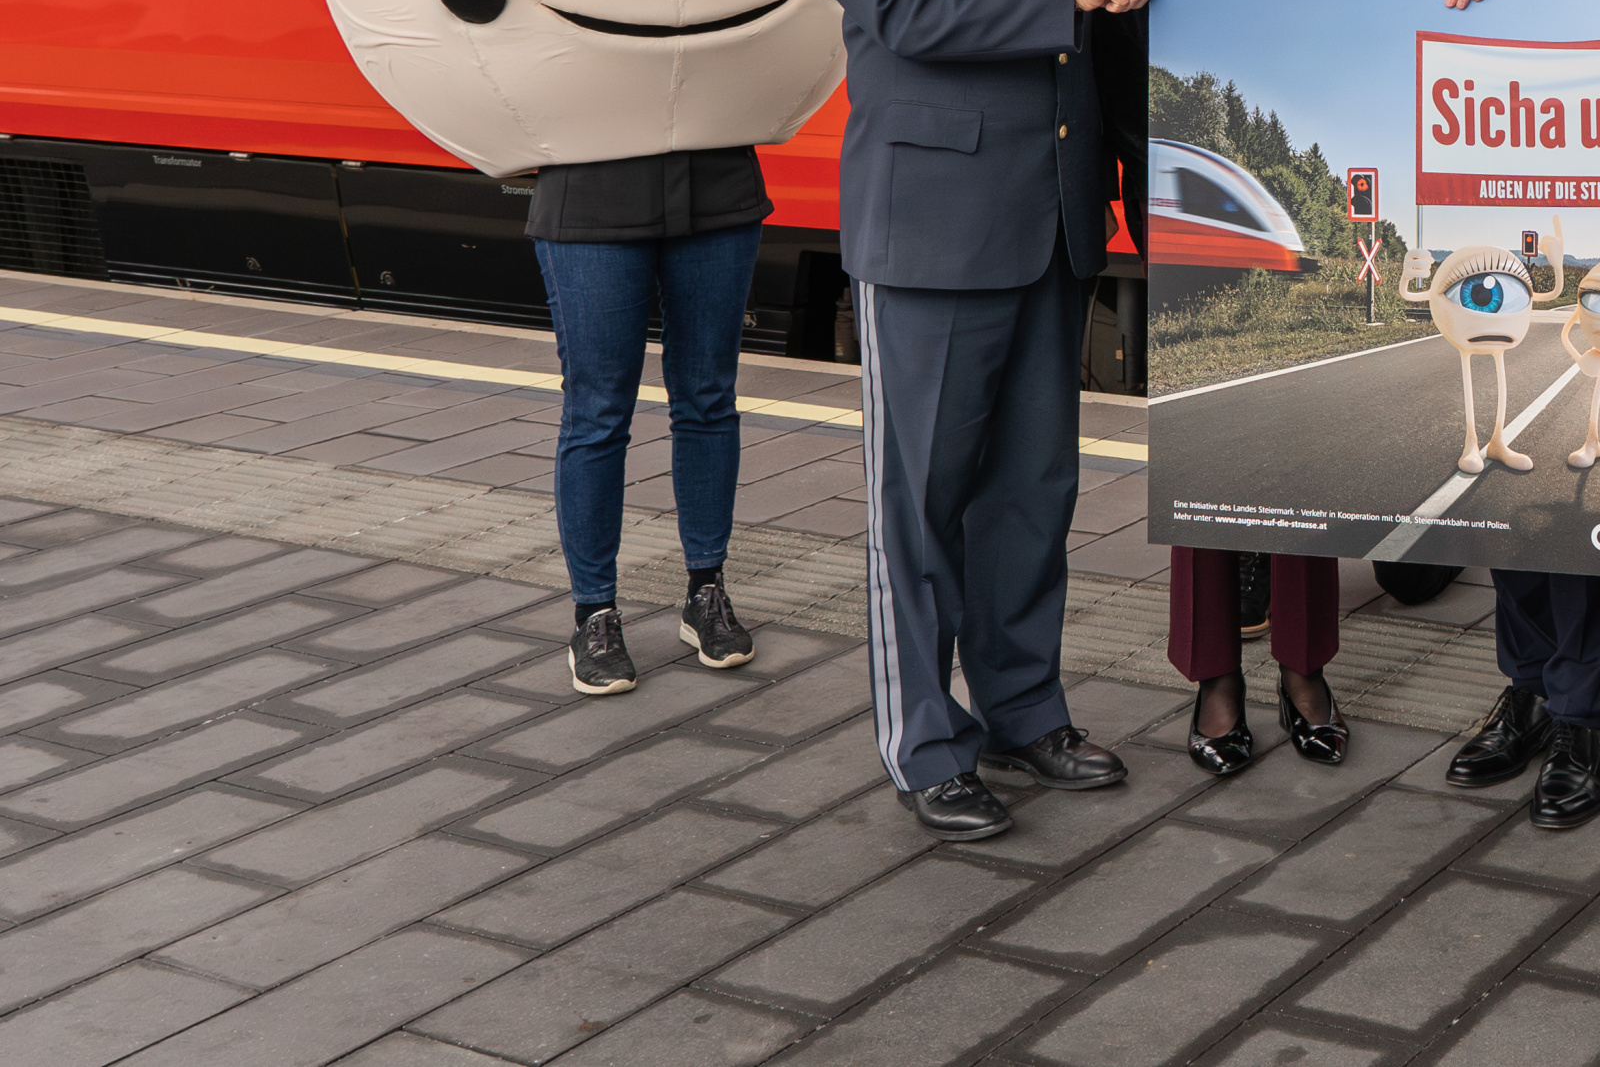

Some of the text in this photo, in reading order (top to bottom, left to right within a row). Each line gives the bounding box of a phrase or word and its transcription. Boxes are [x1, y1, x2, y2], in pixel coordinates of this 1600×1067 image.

[1431, 77, 1566, 149] Sicha
[152, 155, 202, 168] Transformator
[1479, 179, 1523, 199] AUGEN
[1526, 180, 1551, 199] AUF
[1554, 181, 1577, 200] DIE
[1173, 500, 1189, 509] Eine
[1189, 500, 1218, 511] Initiative
[1220, 503, 1232, 512] des
[1232, 504, 1257, 513] Landes
[1258, 506, 1295, 516] Steiermark
[1301, 508, 1328, 518] Verkehr
[1329, 510, 1336, 519] in
[1337, 511, 1380, 522] Kooperation
[1381, 514, 1394, 523] mit
[1414, 516, 1470, 527] Steiermarkbahn
[1471, 520, 1485, 529] und
[1487, 521, 1512, 531] Polizei.
[1173, 512, 1328, 530] Mehr unter: www.augen-auf-die-strasse.at
